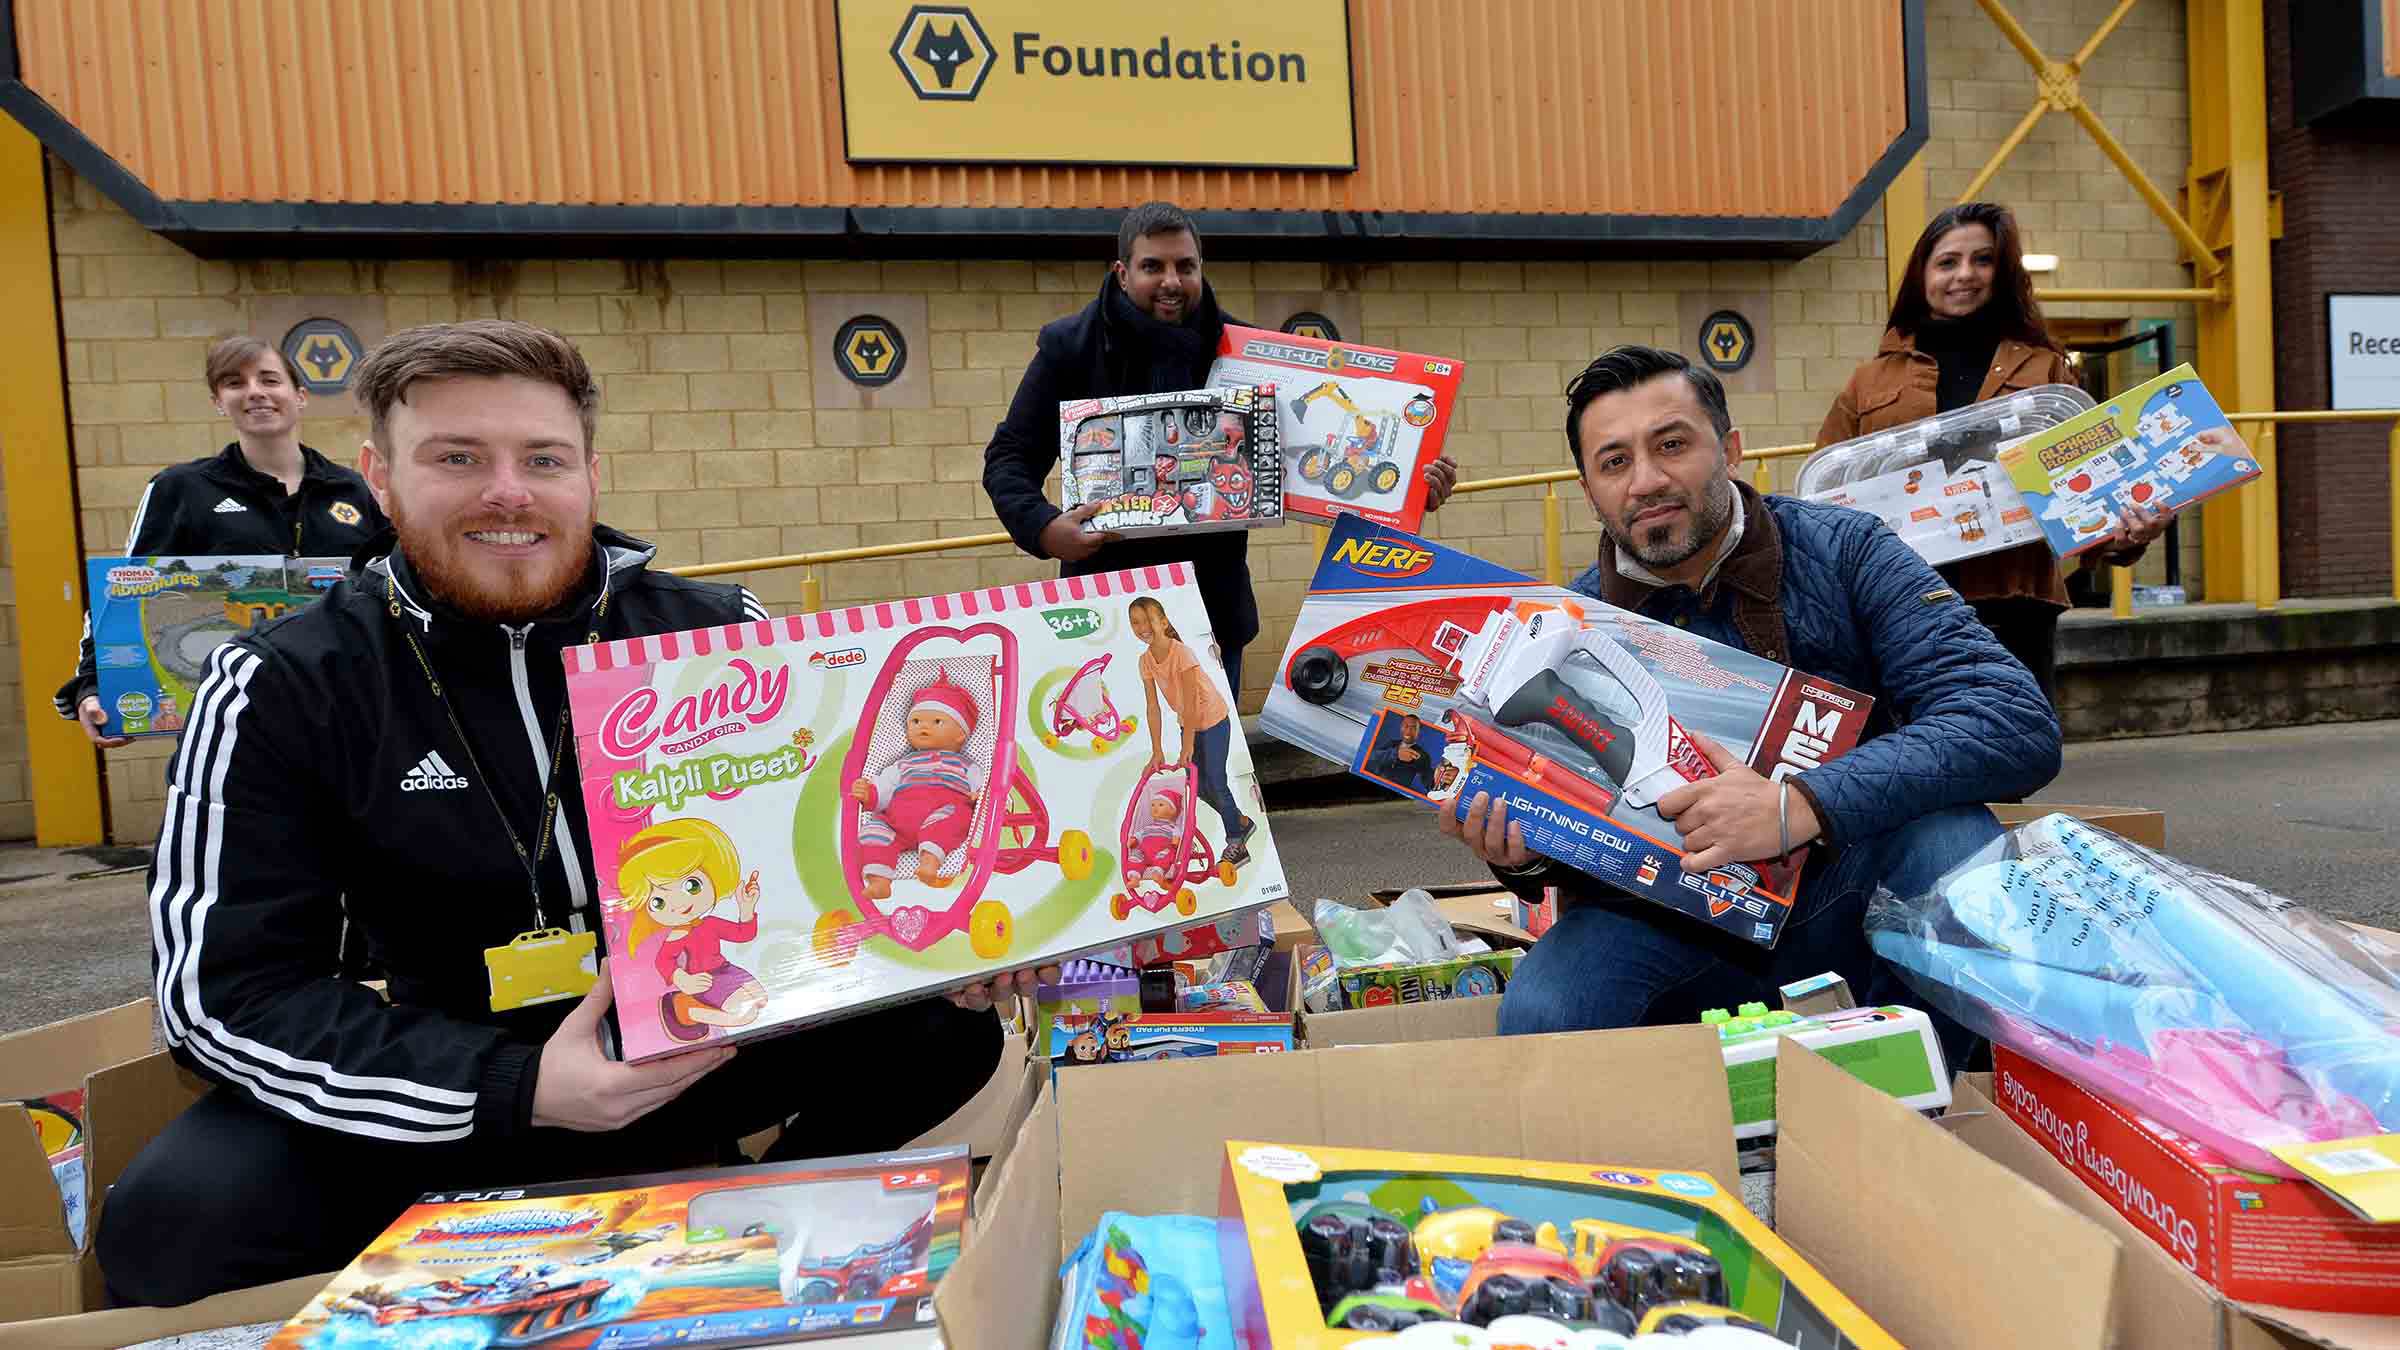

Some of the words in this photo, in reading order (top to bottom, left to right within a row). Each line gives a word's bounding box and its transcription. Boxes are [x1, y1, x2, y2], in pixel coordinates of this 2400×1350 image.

[1013, 32, 1306, 83] Foundation
[1332, 538, 1434, 572] NERF
[828, 650, 862, 666] dede
[602, 658, 789, 760] Candy
[667, 733, 709, 754] CANDY
[715, 723, 744, 738] GIRL
[400, 774, 469, 792] adidas
[620, 764, 703, 804] Kalpli
[712, 750, 800, 786] Puset
[1501, 791, 1590, 836] LIGHTNING
[1591, 829, 1632, 853] BOW
[1684, 875, 1764, 915] ELITE
[1136, 1026, 1153, 1034] PAD
[1154, 1026, 1171, 1034] PUP
[2002, 1070, 2075, 1166] Shortcake
[453, 1189, 526, 1202] PS3
[2076, 1120, 2199, 1272] Strawberry
